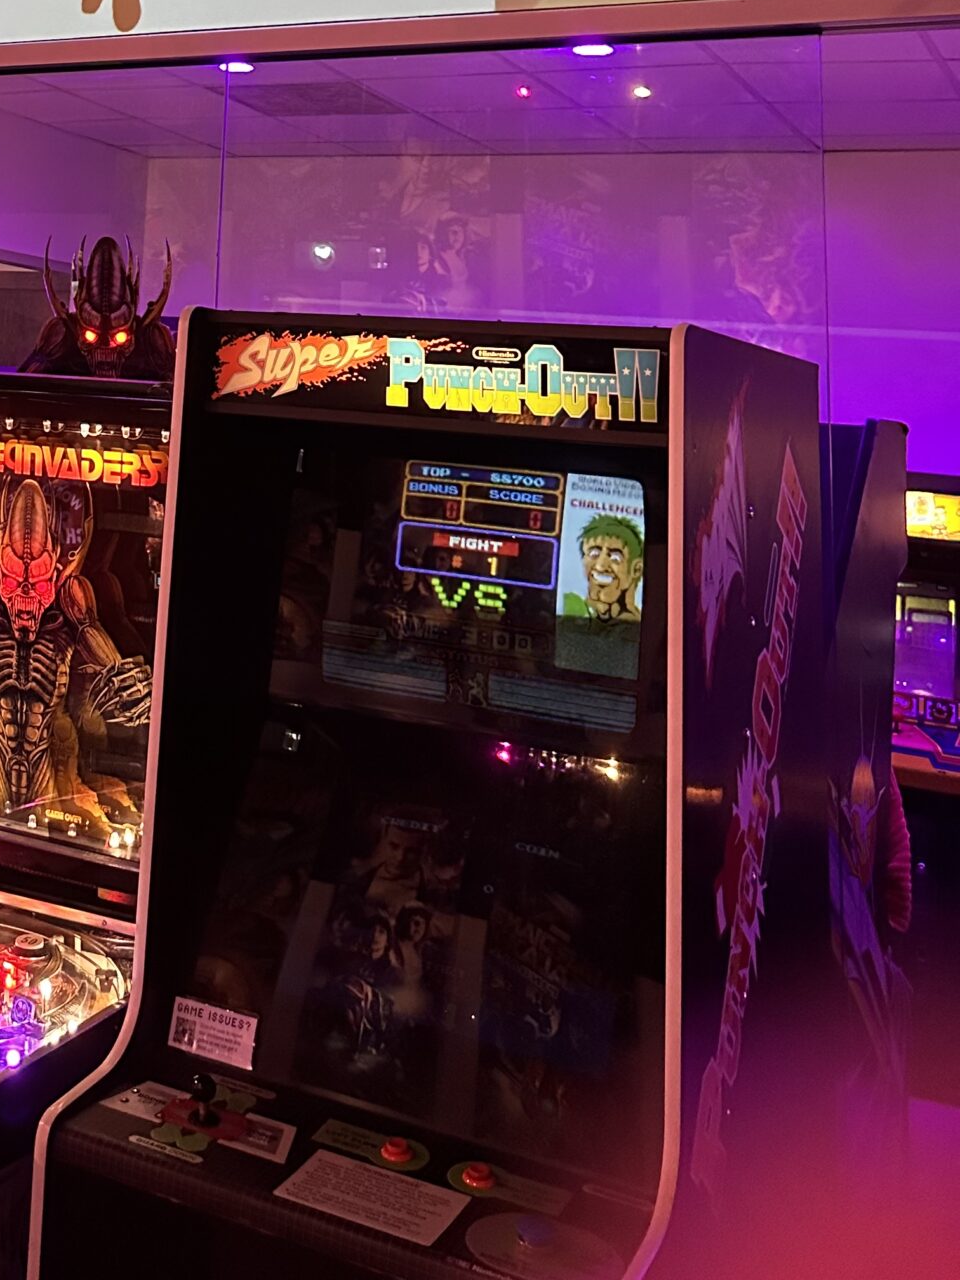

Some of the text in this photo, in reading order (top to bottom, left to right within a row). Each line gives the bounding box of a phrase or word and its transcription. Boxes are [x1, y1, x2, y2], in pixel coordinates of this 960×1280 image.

[218, 333, 378, 399] Super
[14, 440, 161, 487] INVADERS
[421, 465, 451, 478] TOP
[408, 481, 459, 496] BONUS
[489, 489, 544, 505] SCORE
[445, 501, 458, 520] 0
[529, 511, 541, 530] 0
[448, 535, 504, 553] FIGHT
[486, 556, 499, 576] 1
[431, 577, 508, 614] VS
[176, 1002, 252, 1031] GAME ISSUES?
